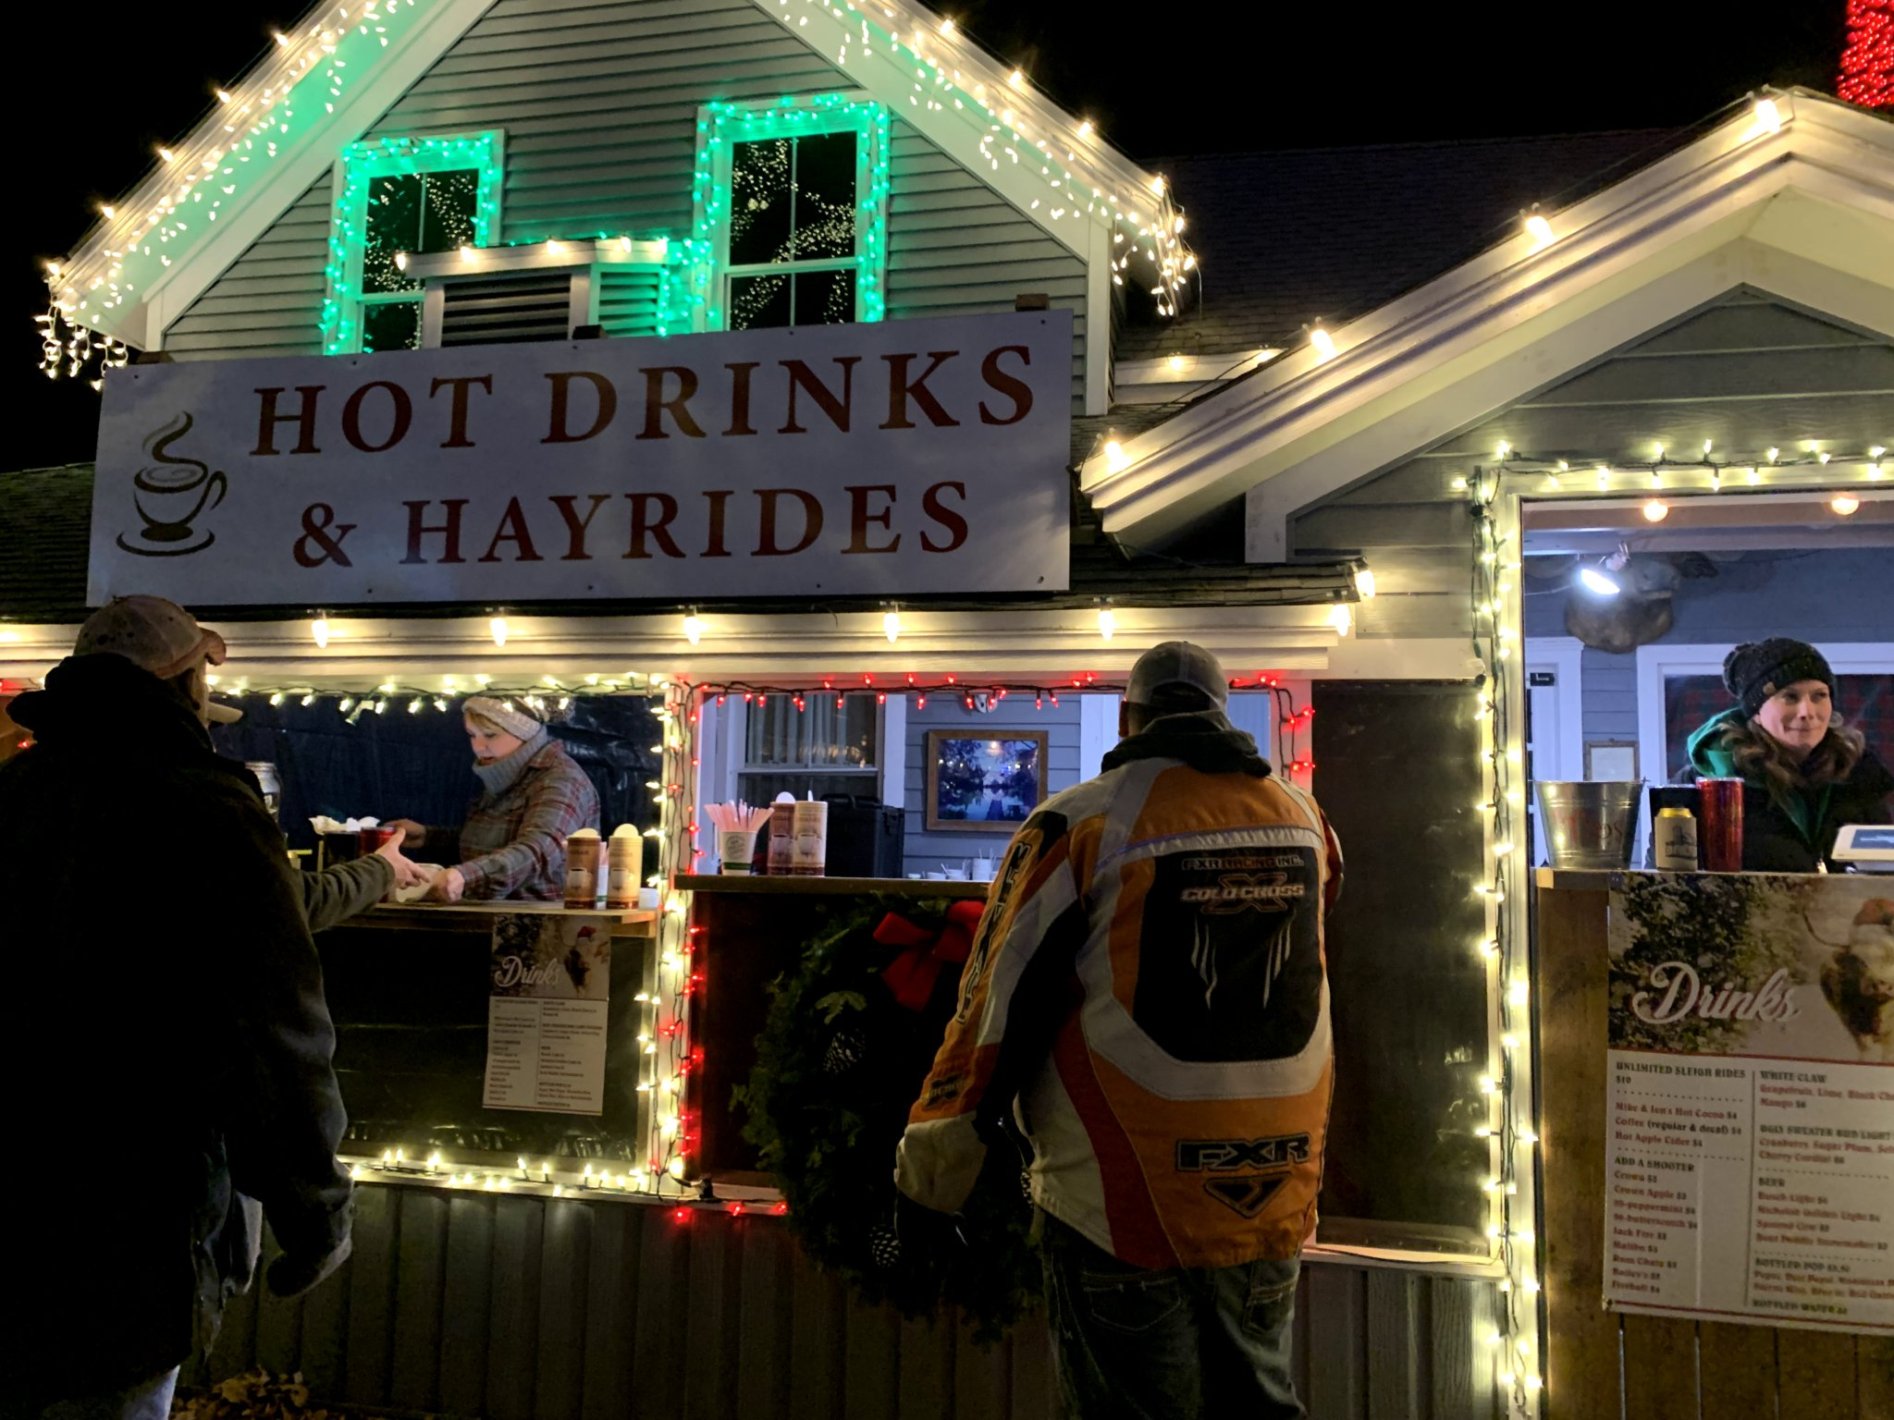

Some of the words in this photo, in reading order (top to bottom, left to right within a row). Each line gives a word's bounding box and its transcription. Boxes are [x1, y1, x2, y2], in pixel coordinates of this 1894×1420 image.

[249, 373, 493, 457] HOT
[540, 344, 1035, 446] DRINKS
[291, 501, 357, 568] &
[399, 480, 969, 566] HAYRIDES
[1182, 857, 1221, 870] FXR
[1180, 886, 1236, 902] COLD
[1238, 883, 1305, 899] CROSS
[494, 955, 560, 988] Drinks
[1632, 961, 1801, 1025] Drinks
[1616, 1061, 1672, 1074] UNLIMITED
[1675, 1065, 1712, 1077] SLEIGH
[1715, 1067, 1746, 1078] RIDES
[1760, 1070, 1794, 1081] WHITE
[1797, 1073, 1827, 1084] CLAW
[1615, 1102, 1638, 1112] Mike
[1641, 1104, 1648, 1112] &
[1675, 1107, 1693, 1117] Hot
[1695, 1108, 1725, 1119] Cocoa
[1615, 1116, 1644, 1127] Coffee
[1647, 1119, 1686, 1132] (regular
[1690, 1123, 1697, 1132] &
[1699, 1124, 1729, 1136] decaf)
[1615, 1131, 1633, 1140] Hot
[1635, 1132, 1662, 1144] Apple
[1664, 1135, 1690, 1146] Cider
[1176, 1132, 1311, 1173] FXR
[1614, 1156, 1635, 1166] ADD
[1638, 1158, 1645, 1168] A
[1647, 1160, 1695, 1172] SHOOTER
[1614, 1170, 1645, 1182] Crown
[1758, 1177, 1785, 1187] BEER
[1614, 1185, 1645, 1197] Crown
[1647, 1188, 1674, 1199] Apple
[1613, 1226, 1633, 1237] Jack
